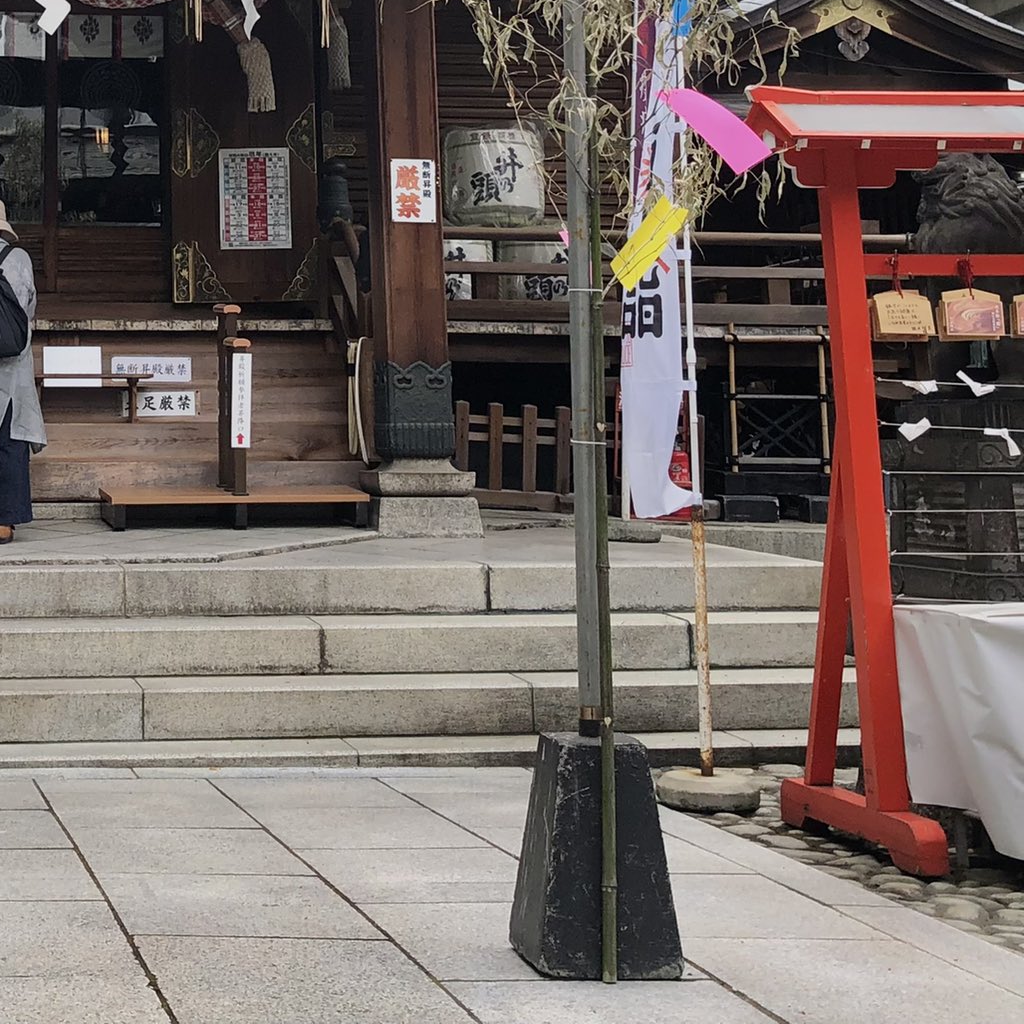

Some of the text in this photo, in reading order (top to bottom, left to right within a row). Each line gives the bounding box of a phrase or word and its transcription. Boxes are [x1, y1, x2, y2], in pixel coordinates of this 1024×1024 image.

[396, 165, 421, 218] 厳禁
[116, 363, 187, 376] 無断昇殿厳禁
